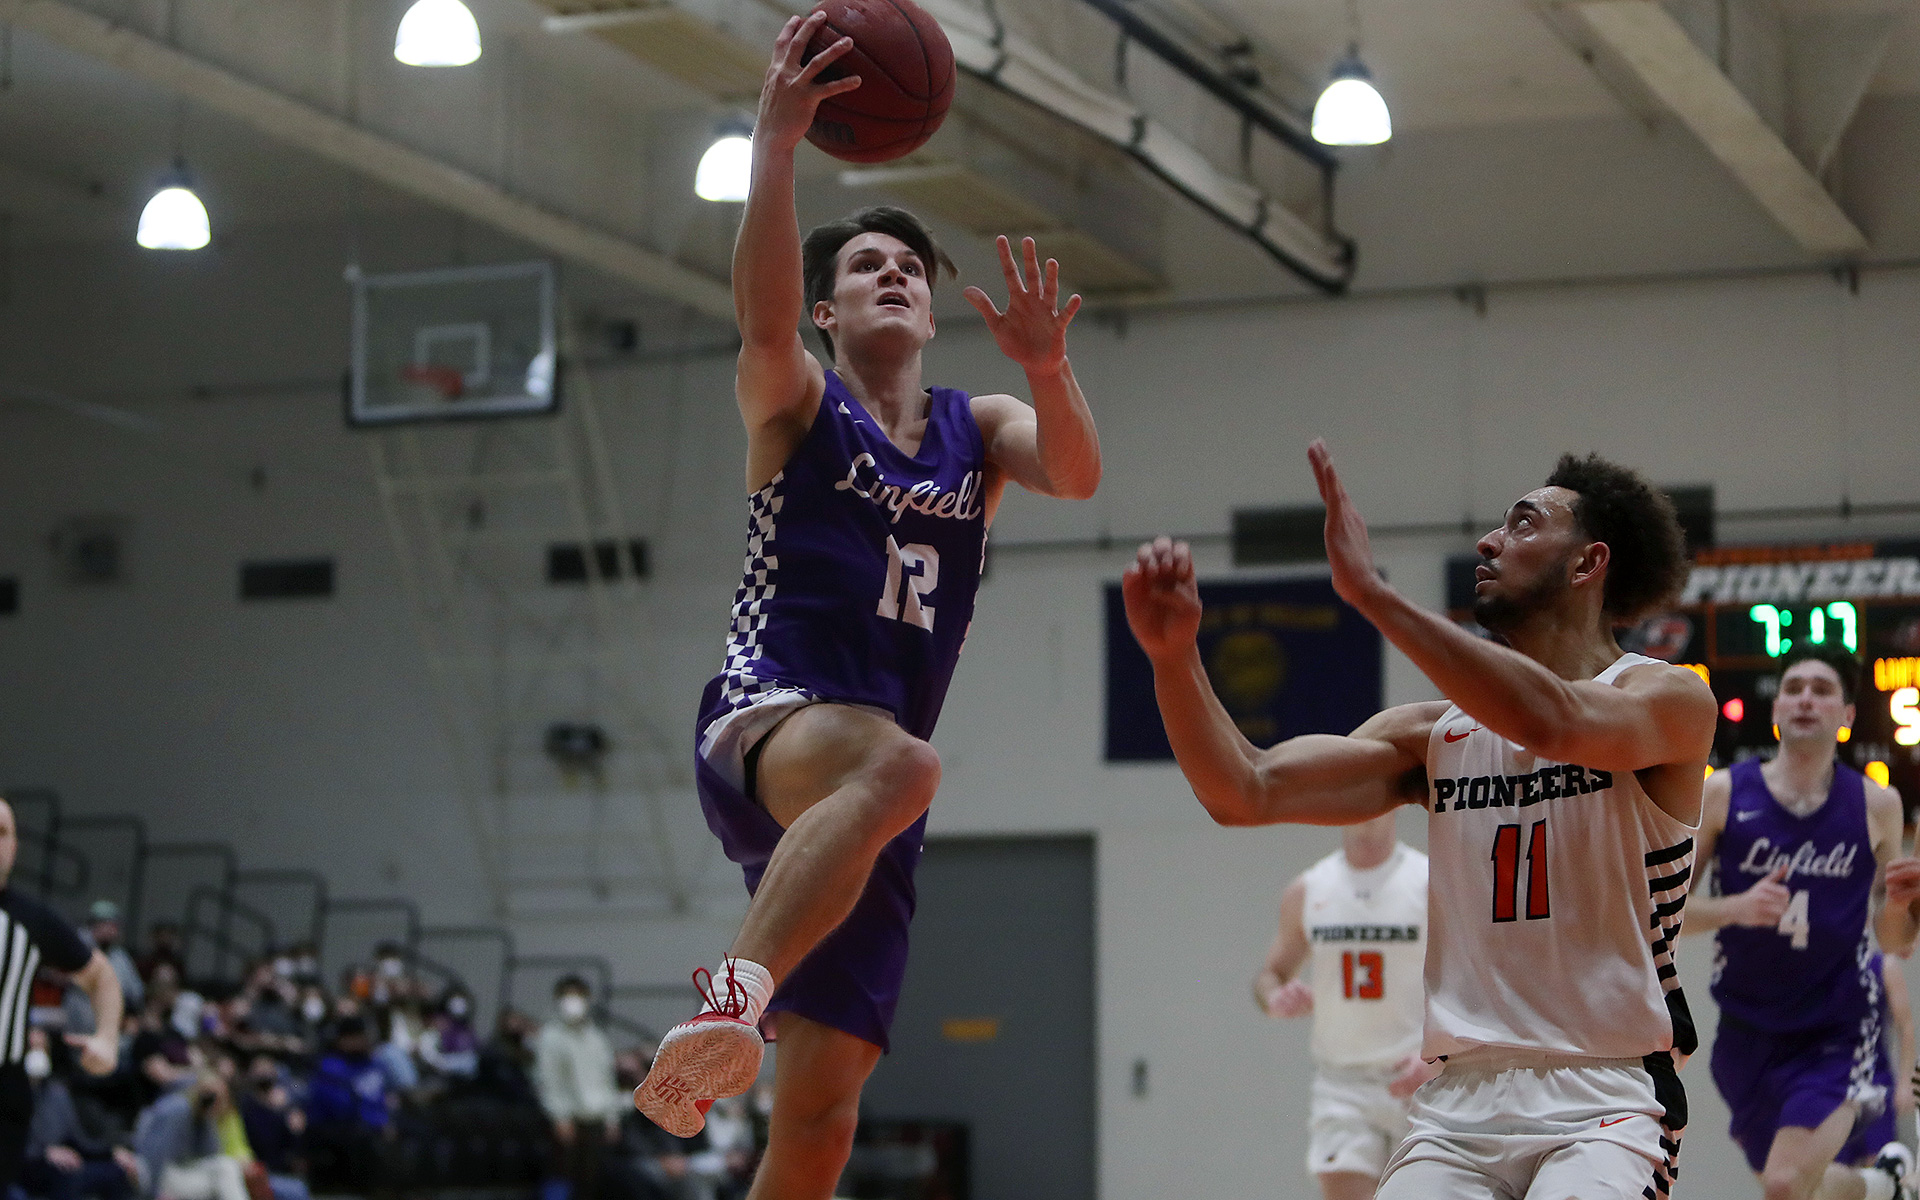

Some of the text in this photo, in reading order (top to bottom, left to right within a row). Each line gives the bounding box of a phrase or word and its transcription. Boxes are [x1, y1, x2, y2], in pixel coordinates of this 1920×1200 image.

[876, 534, 940, 633] 12
[1750, 602, 1857, 658] 7:17
[1434, 764, 1613, 813] PIONEERS
[1491, 818, 1551, 923] 11
[1739, 836, 1857, 882] Linfield
[1311, 924, 1419, 942] PIONEERS
[1778, 889, 1809, 950] 4
[1341, 951, 1384, 1000] 13
